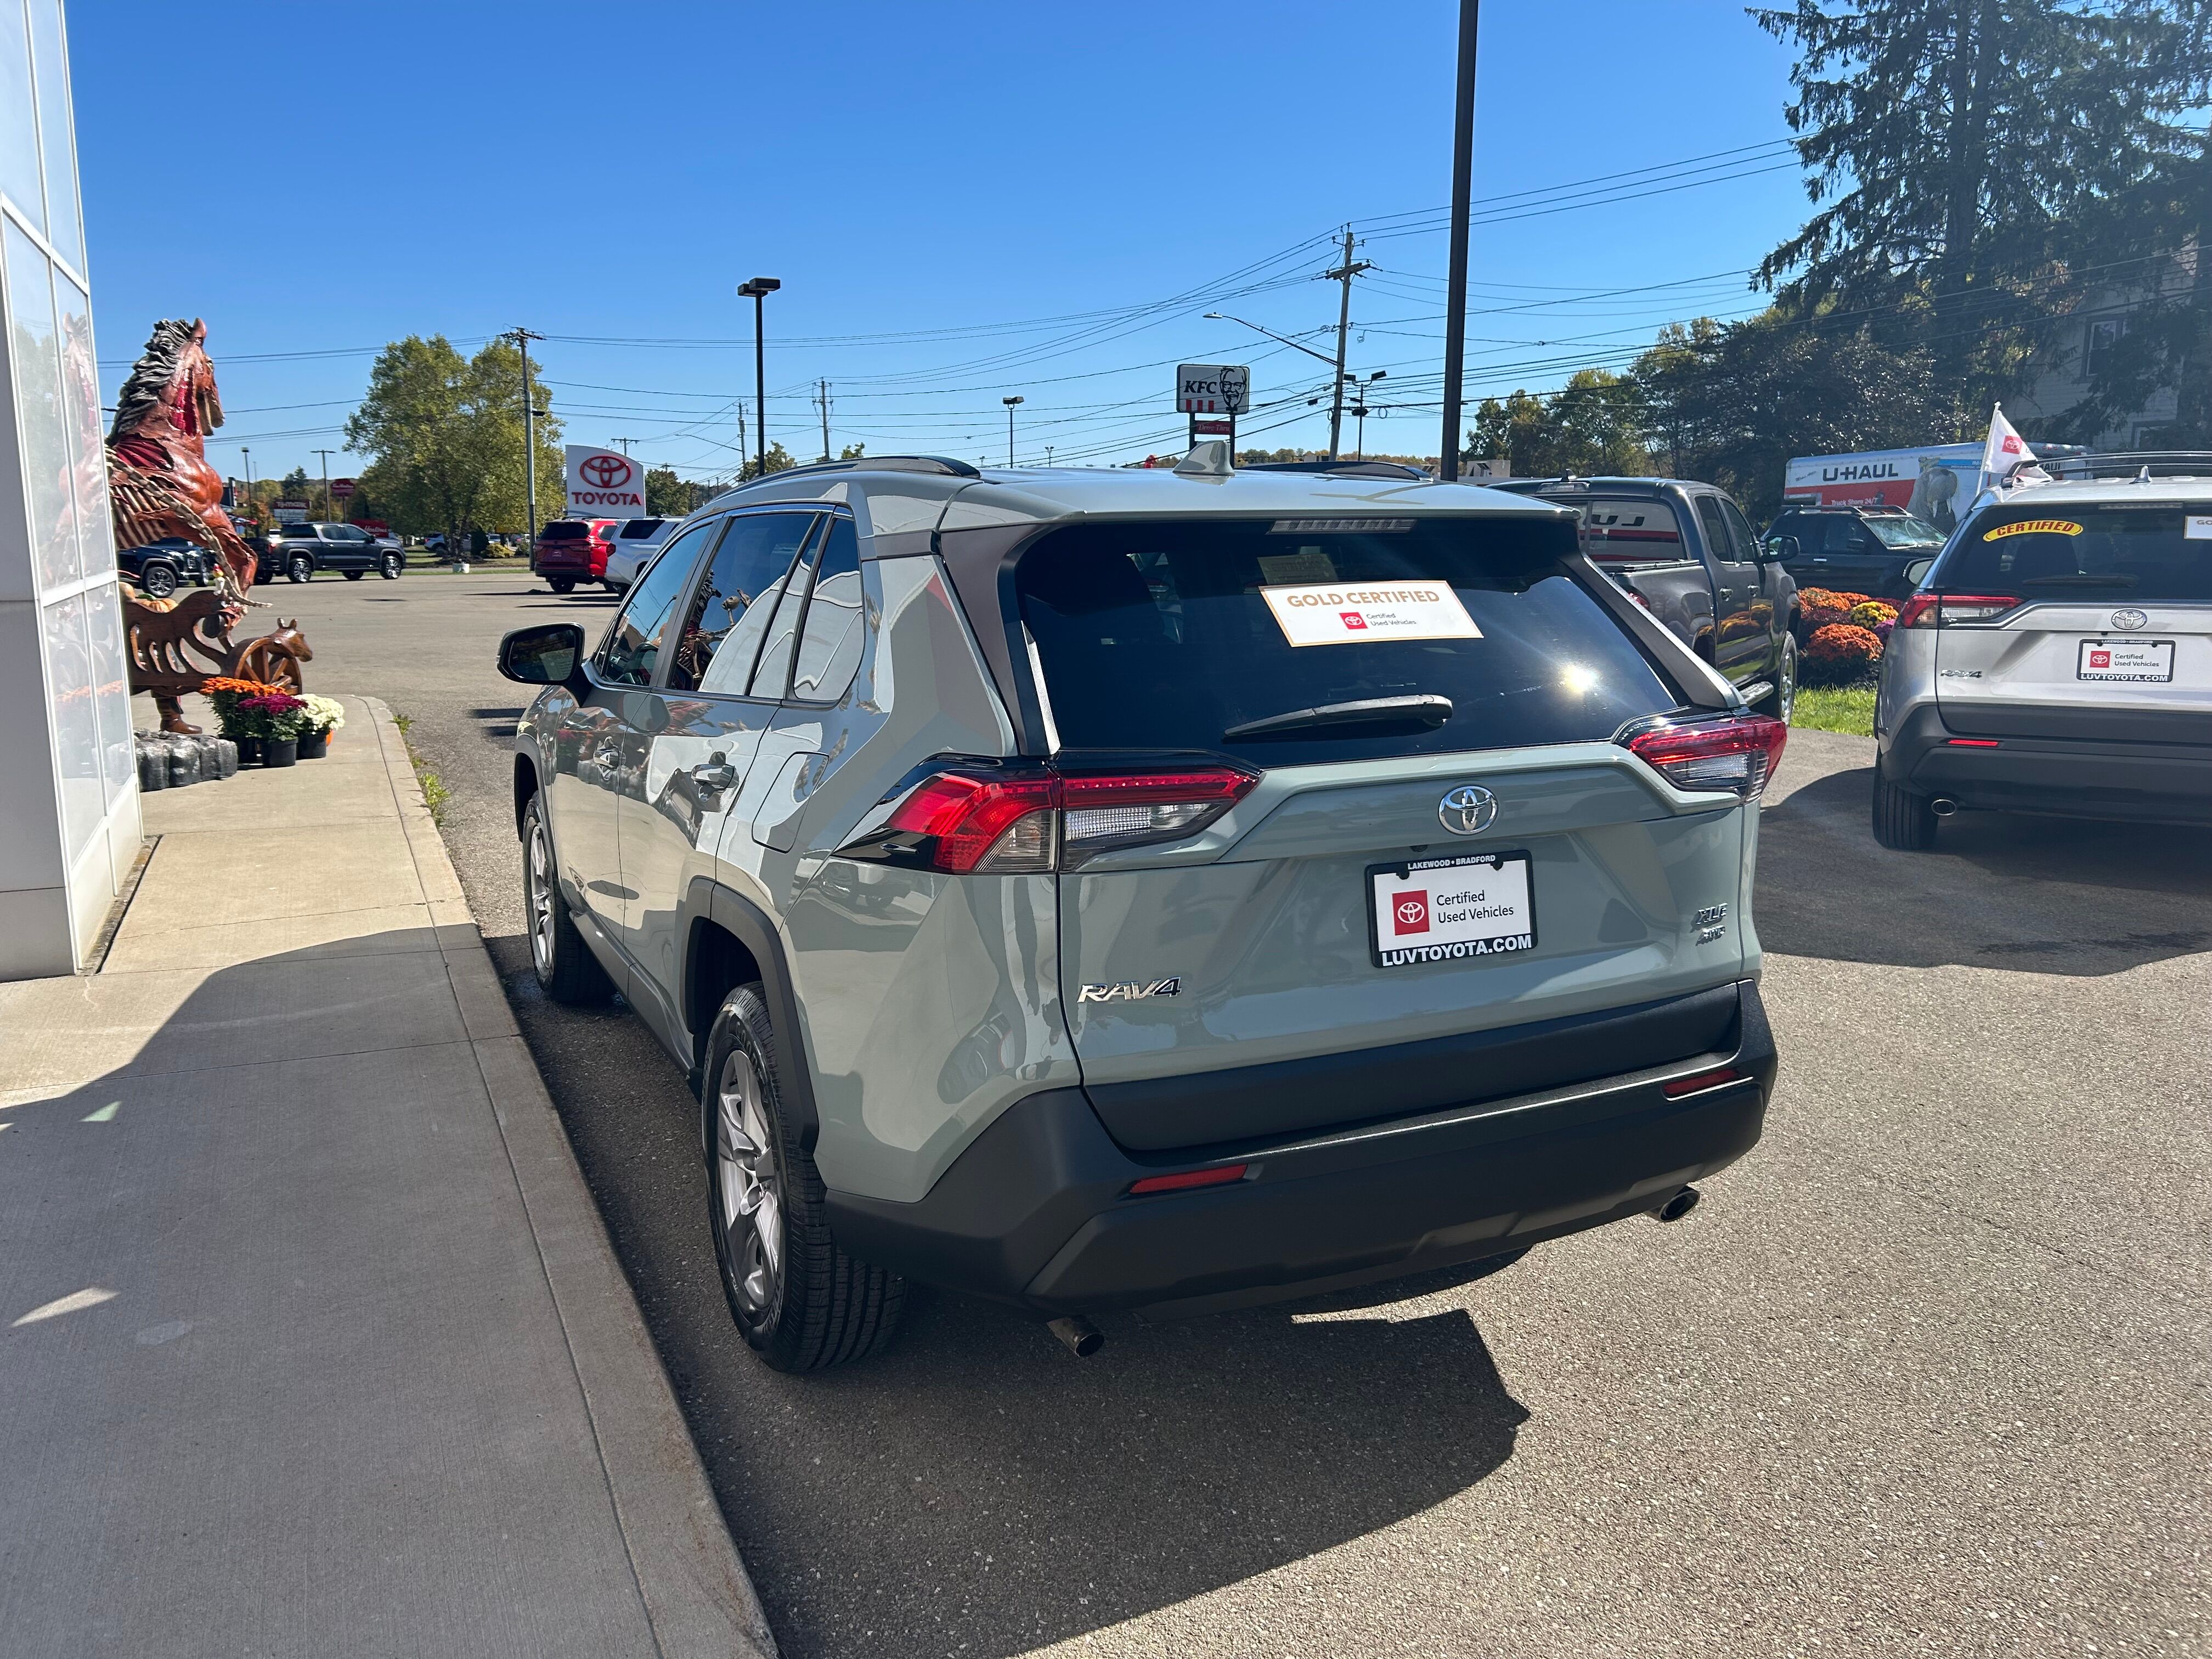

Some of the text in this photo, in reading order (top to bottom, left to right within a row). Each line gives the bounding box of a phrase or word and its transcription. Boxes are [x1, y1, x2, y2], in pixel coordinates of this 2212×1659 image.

[1183, 380, 1217, 394] KFC
[1822, 463, 1898, 481] U-HAUL
[572, 492, 641, 505] TOYOTA
[1997, 521, 2075, 536] CERTIFIED
[1286, 590, 1440, 607] GOLD CERTIFIED
[2081, 673, 2168, 681] LUVTOYOTA.COM
[1407, 854, 1496, 870] LAKEWOOD BRADFORD
[1436, 889, 1485, 906] Certified
[1437, 905, 1514, 923] Used Vehicles
[1381, 934, 1532, 967] LUVTOYOTA.COM
[1076, 975, 1182, 1003] RAV4
